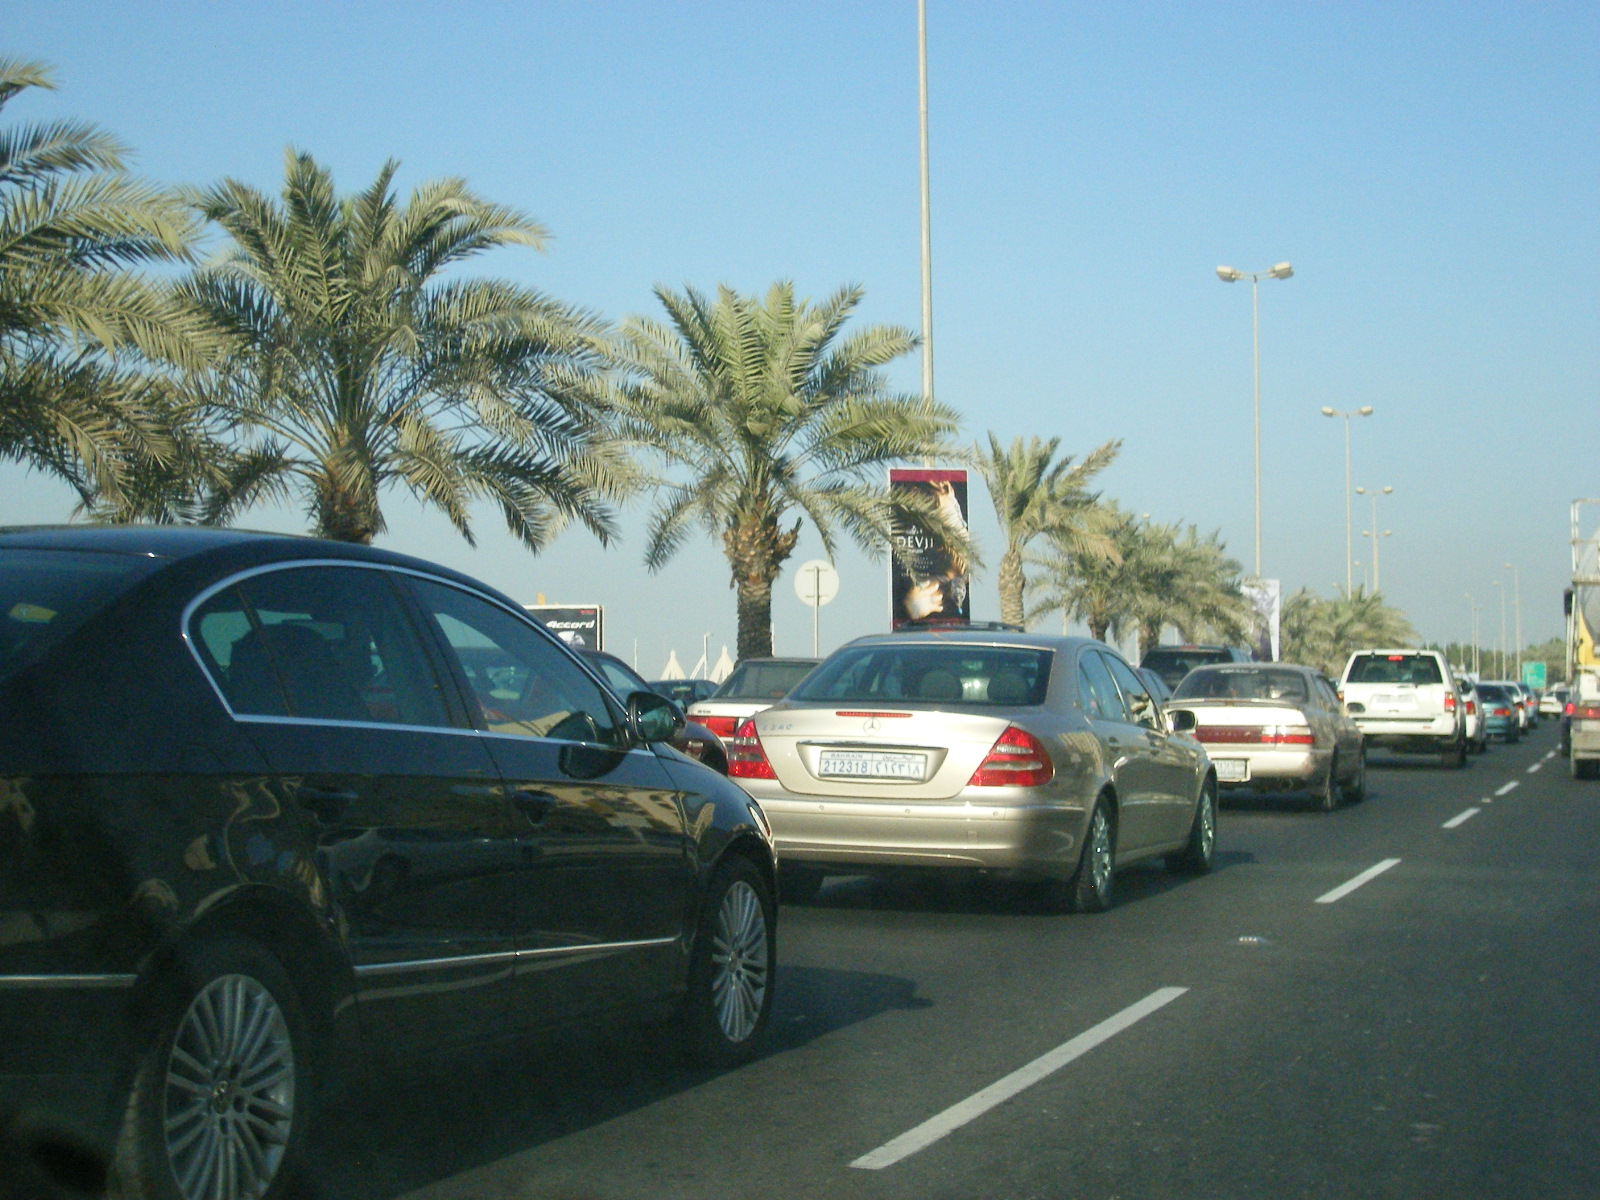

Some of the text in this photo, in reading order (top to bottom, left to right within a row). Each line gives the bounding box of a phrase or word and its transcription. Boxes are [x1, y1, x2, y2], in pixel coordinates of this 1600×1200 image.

[896, 535, 934, 550] DEVJI
[546, 619, 595, 629] Accord
[823, 760, 868, 774] 212318
